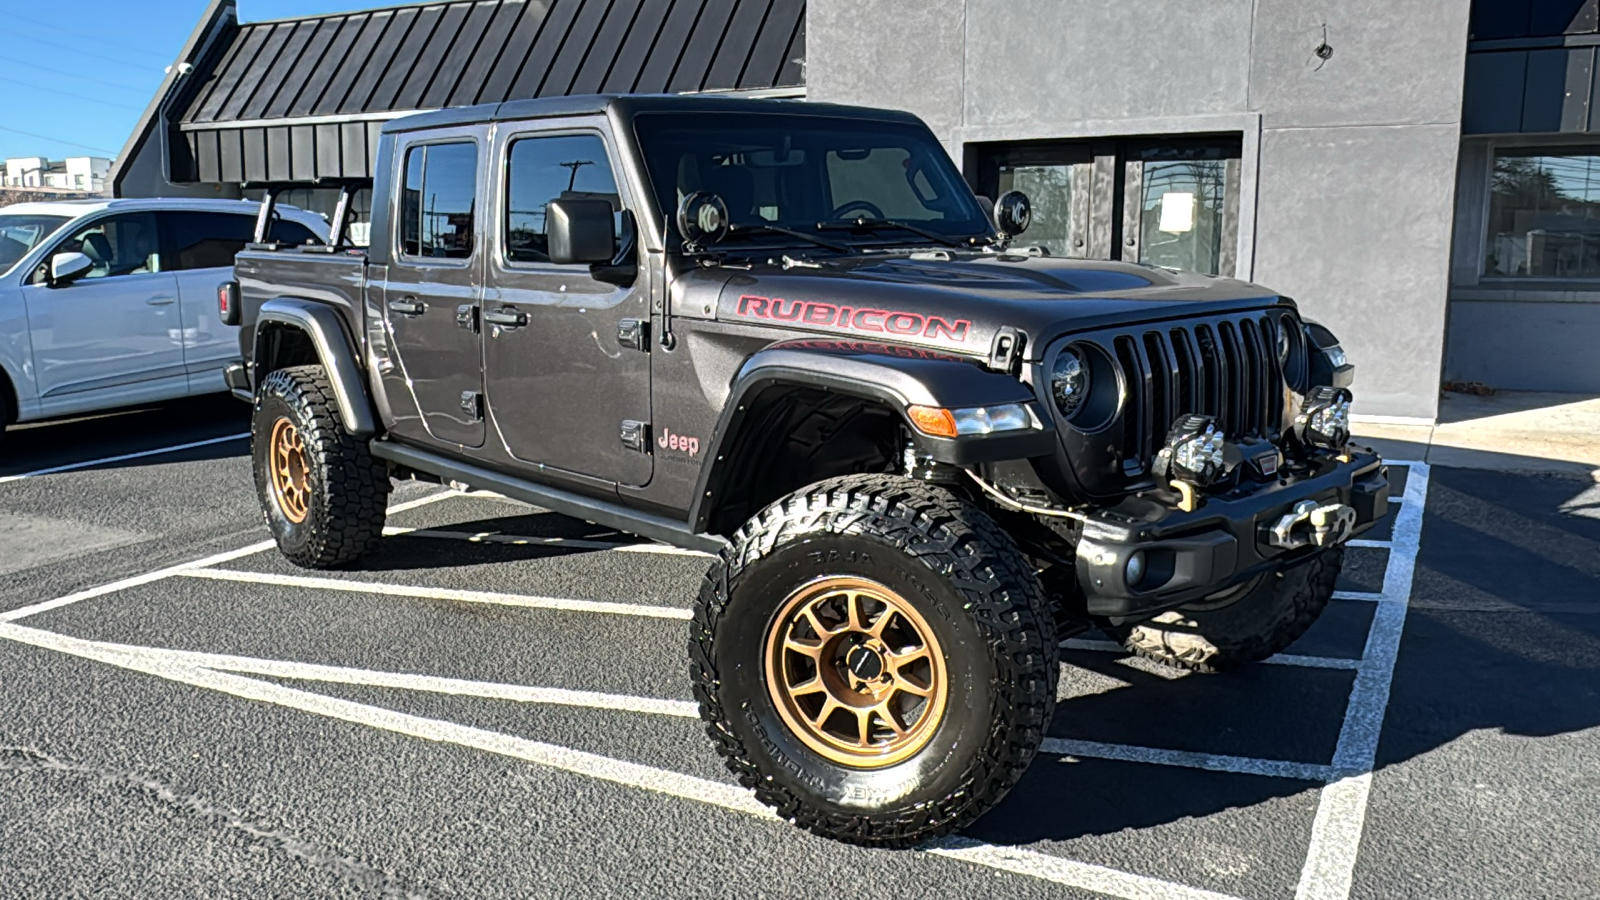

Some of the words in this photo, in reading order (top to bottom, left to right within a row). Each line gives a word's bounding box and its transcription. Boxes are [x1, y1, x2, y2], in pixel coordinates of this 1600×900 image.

[698, 203, 720, 233] KC
[1012, 201, 1026, 225] KC
[735, 294, 972, 341] RUBICON
[657, 426, 700, 457] Jeep
